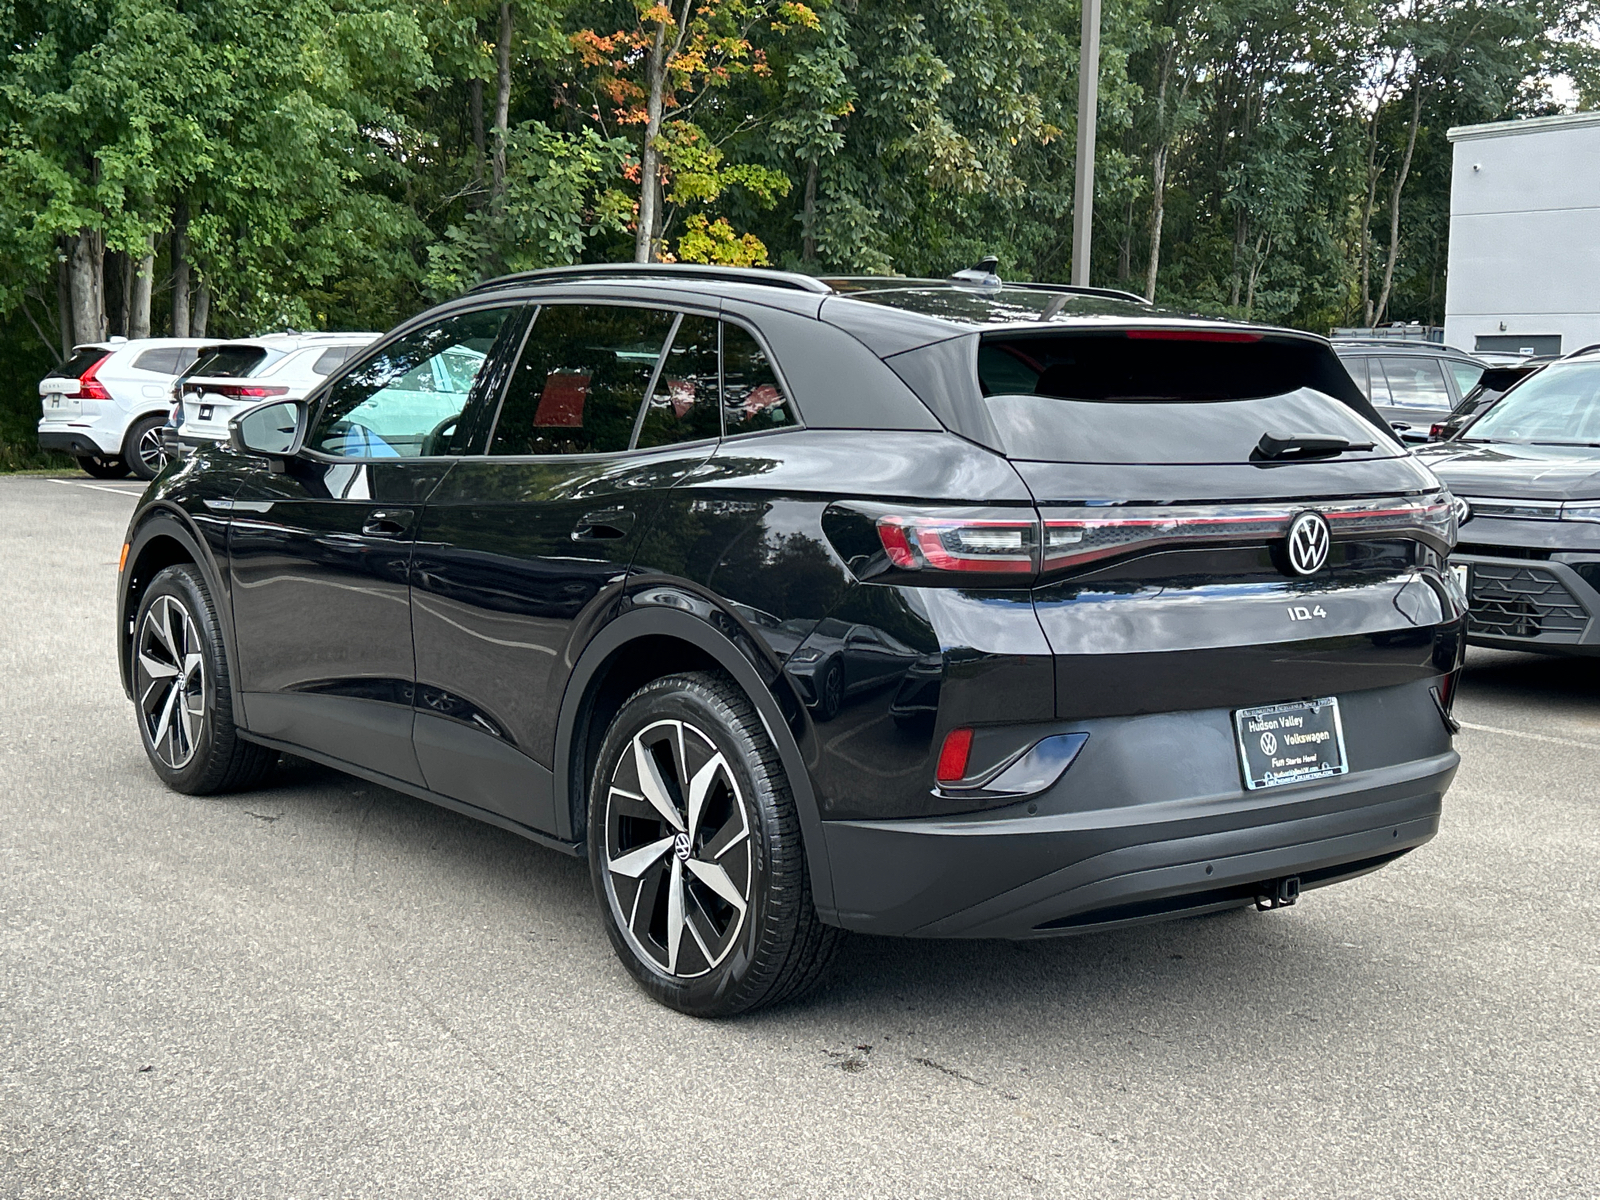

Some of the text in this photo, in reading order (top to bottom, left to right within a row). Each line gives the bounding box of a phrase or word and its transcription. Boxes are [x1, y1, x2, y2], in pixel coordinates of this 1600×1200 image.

[1248, 716, 1303, 732] Hudson Valley
[1284, 731, 1330, 745] Volkswagen
[1271, 757, 1285, 768] Fun
[1286, 757, 1302, 766] Starts
